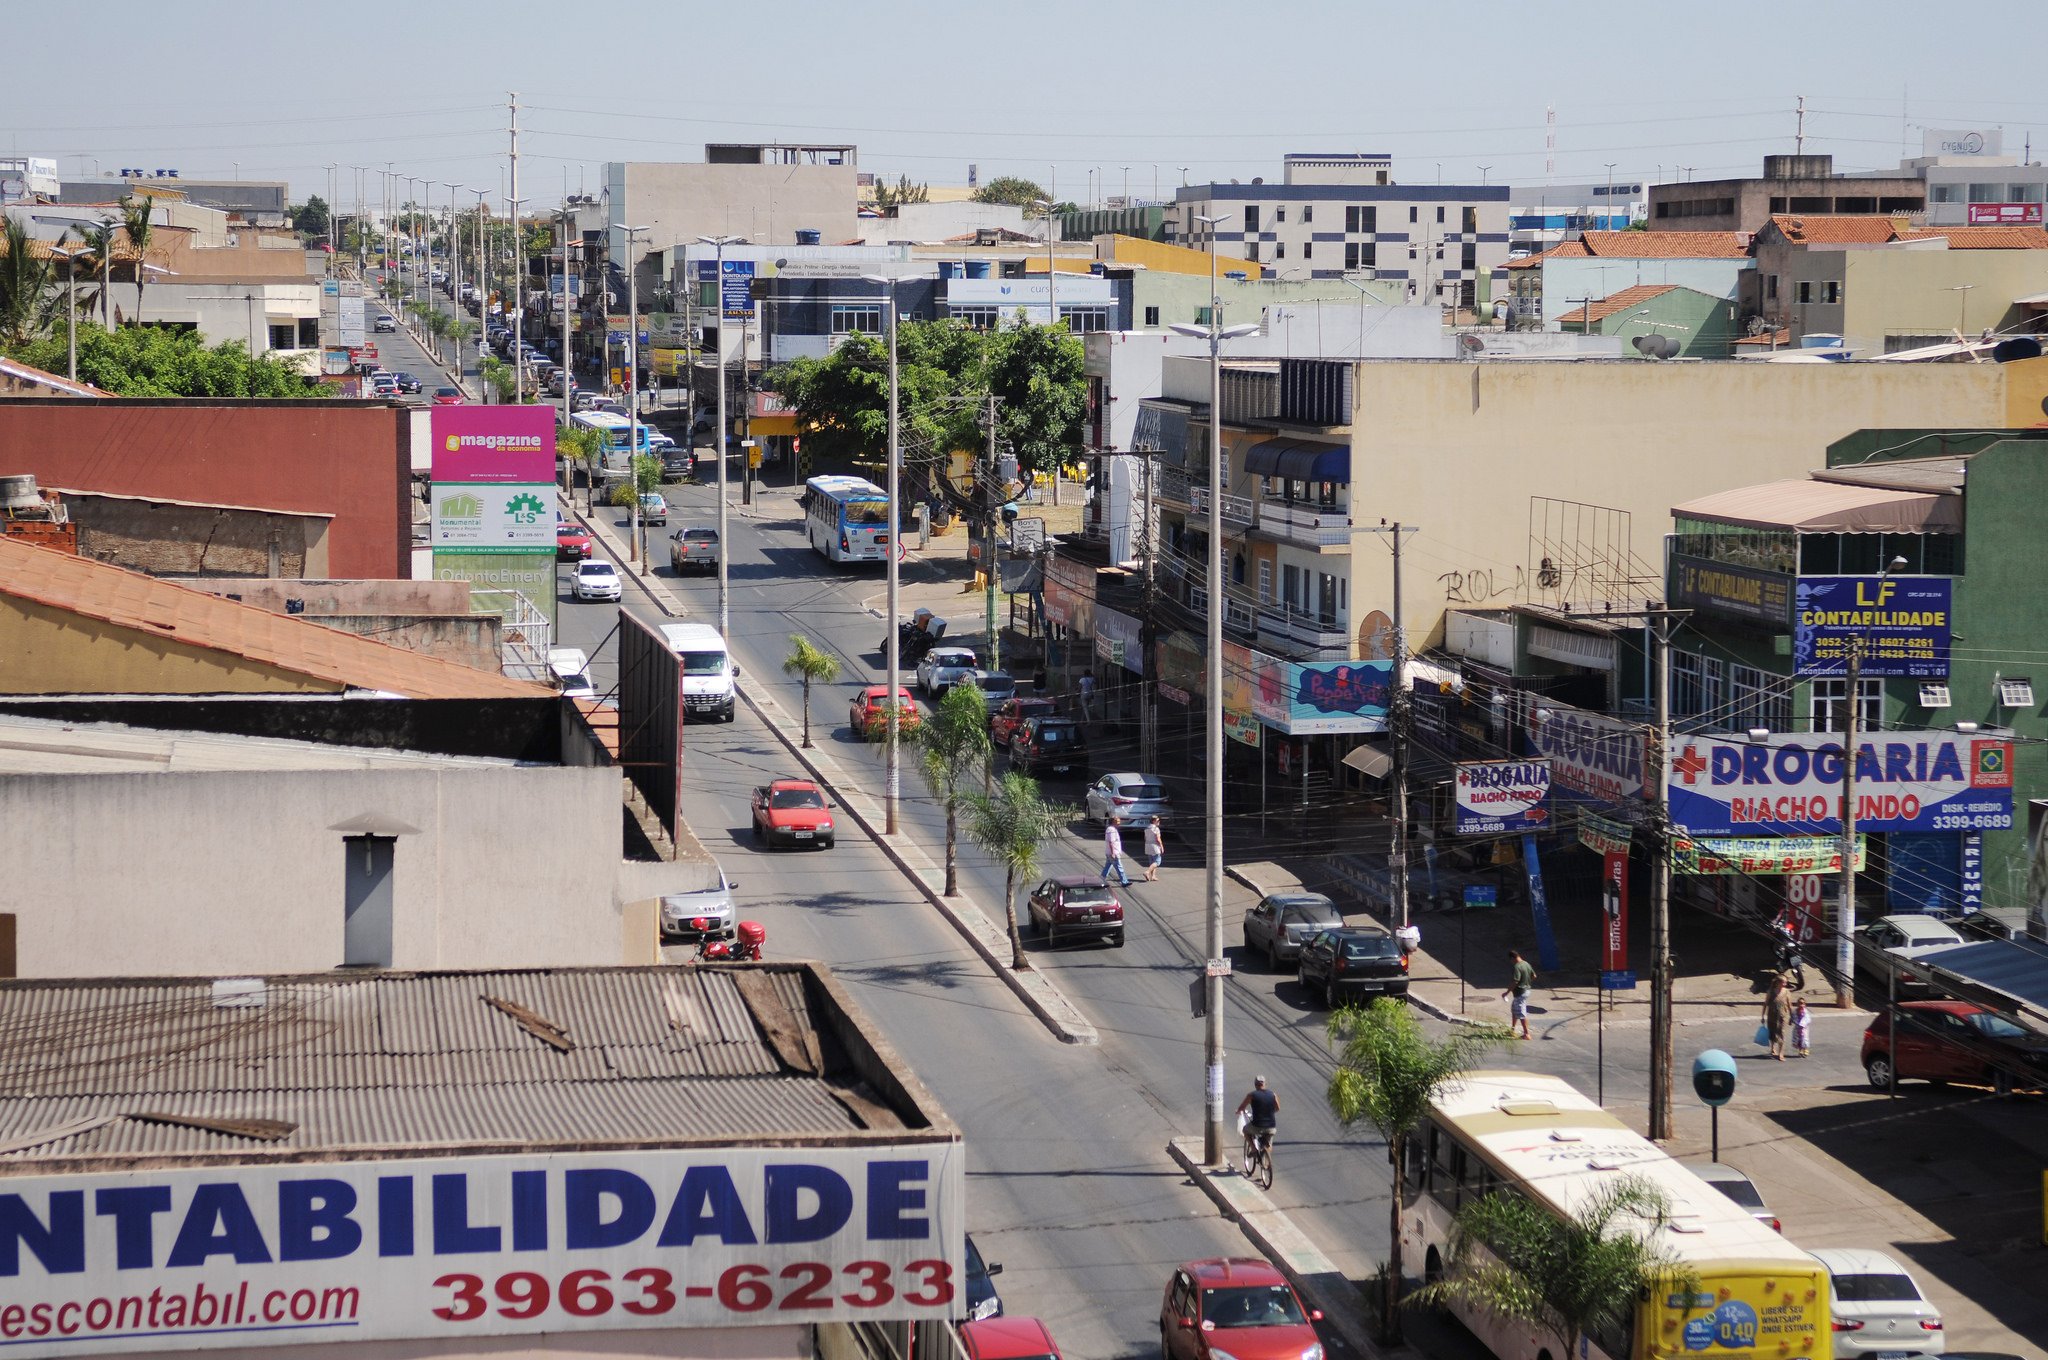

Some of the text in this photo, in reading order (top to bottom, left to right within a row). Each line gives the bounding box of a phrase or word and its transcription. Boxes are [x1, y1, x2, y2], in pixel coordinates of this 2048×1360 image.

[1942, 142, 1974, 151] CYGNUS
[461, 436, 541, 448] magazine
[1698, 570, 1761, 605] CONTABILIDADE
[1856, 582, 1897, 606] LF
[1802, 612, 1945, 626] CONTABILIDADE
[1543, 711, 1642, 784] DROGARIA
[1471, 764, 1549, 788] DROGARIA
[1712, 742, 1965, 786] DROGARIA
[1471, 790, 1541, 803] RIACHO FUNDO
[1589, 772, 1622, 806] FUNDO
[1730, 796, 1827, 822] RIACHO
[1459, 823, 1505, 833] 3399-6689
[1932, 815, 2011, 829] 3399-6689
[1789, 874, 1821, 903] 80
[432, 1260, 954, 1322] 3963-6233
[0, 1281, 359, 1337] escontabil.com
[1761, 1315, 1801, 1324] WHATSAPP
[1762, 1324, 1782, 1333] ONDE
